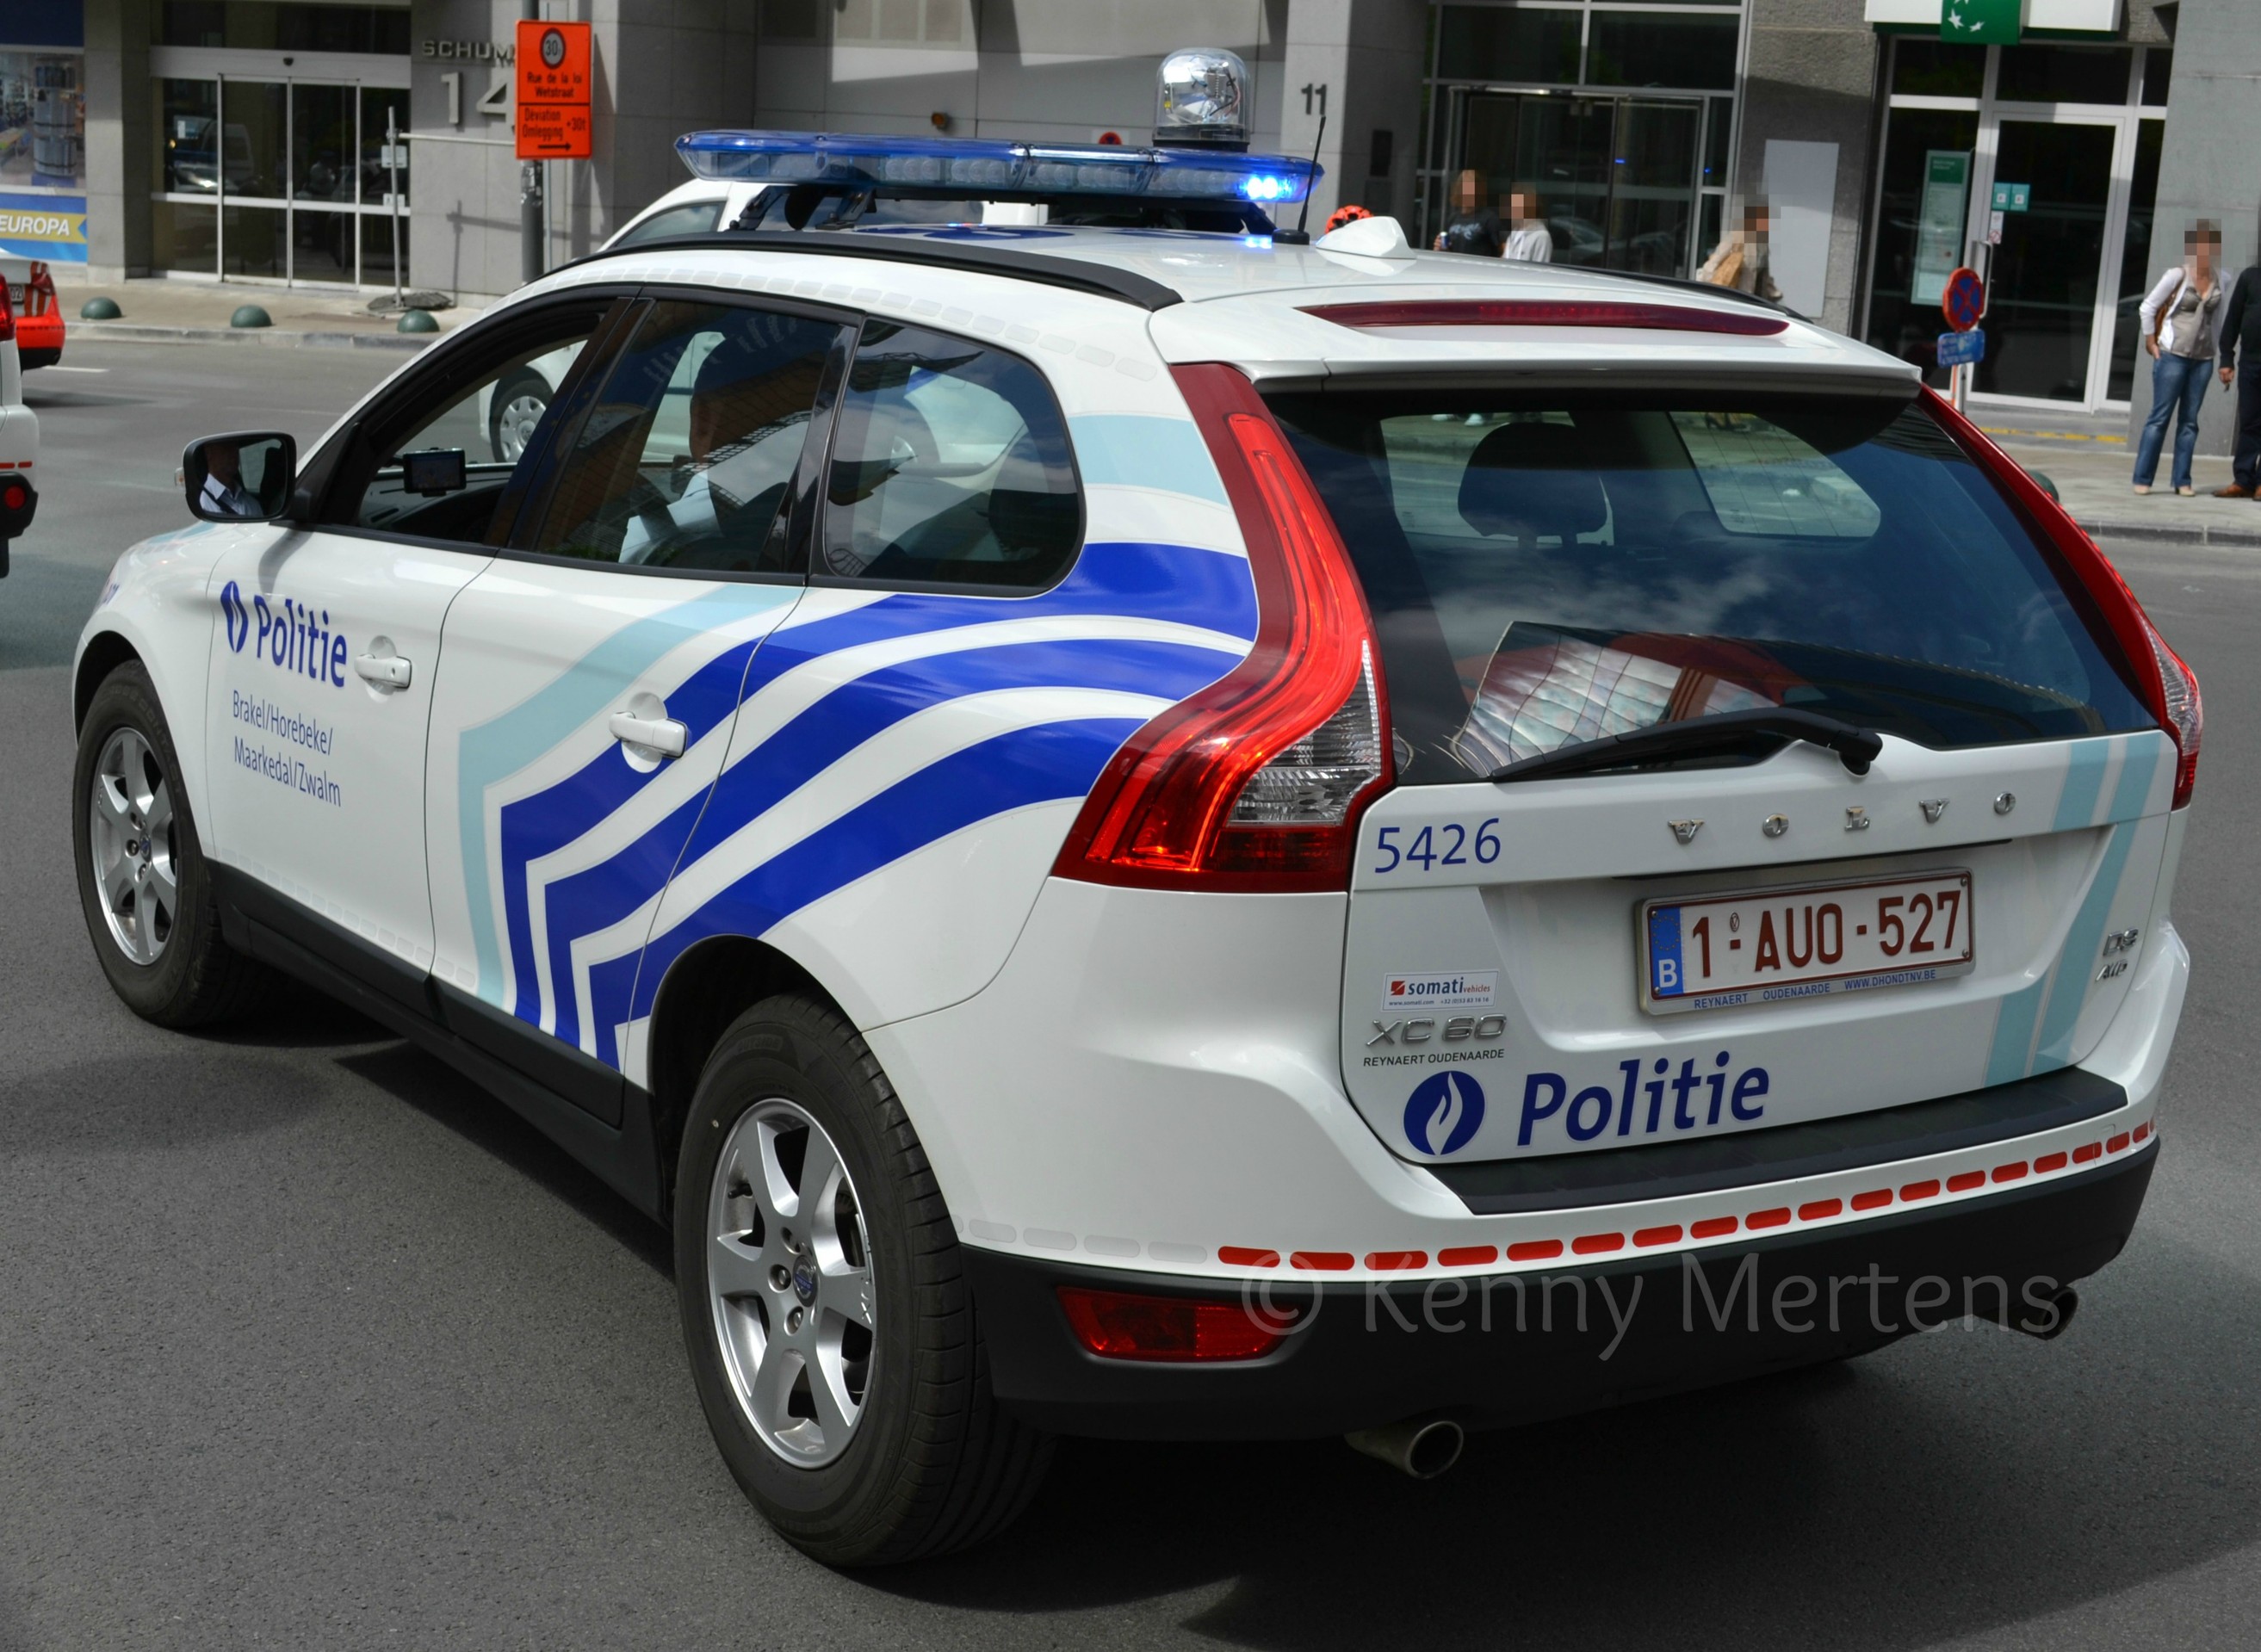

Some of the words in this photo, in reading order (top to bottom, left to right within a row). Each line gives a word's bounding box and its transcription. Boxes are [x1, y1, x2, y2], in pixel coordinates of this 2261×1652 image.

[527, 72, 542, 84] Rue
[547, 72, 557, 84] de
[535, 88, 575, 98] Wetstraat
[1300, 84, 1327, 115] 11
[522, 123, 564, 142] Omlegging
[0, 214, 70, 236] EUROPA
[254, 594, 348, 689] Politie
[232, 689, 334, 757] Brakel/Horebeke/
[234, 735, 342, 807] Maarkedal/Zwalm
[1668, 790, 2016, 845] VOLVO
[1374, 817, 1502, 874] 5426
[1408, 976, 1465, 996] somati
[1464, 983, 1490, 993] vehicles
[1658, 958, 1678, 988] B
[1694, 992, 1749, 1010] REYNAERT
[1762, 982, 1831, 1001] OUDENAARDE
[1844, 969, 1937, 991] WWW.DHONDTNV.BE
[1363, 1055, 1425, 1067] REYNAERT
[1428, 1049, 1505, 1064] OUDENAARDE
[1516, 1050, 1770, 1147] Politie
